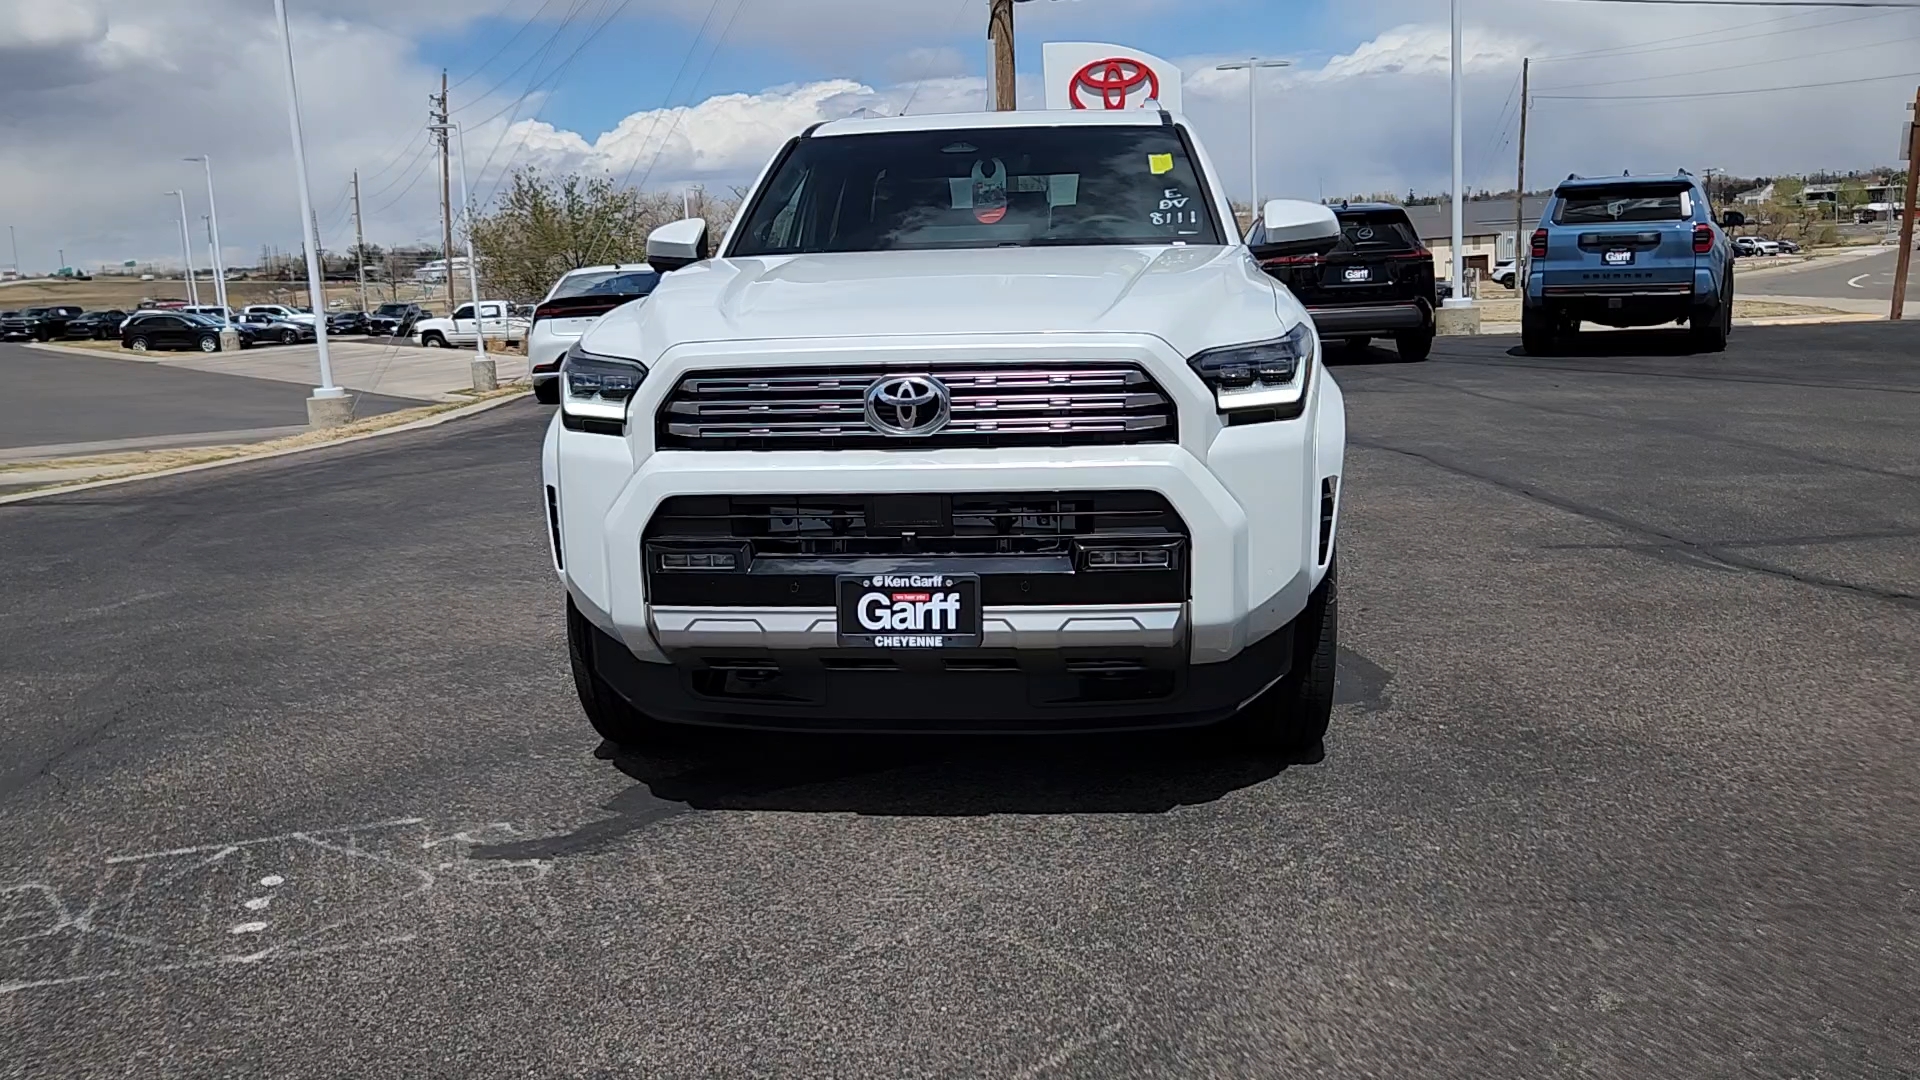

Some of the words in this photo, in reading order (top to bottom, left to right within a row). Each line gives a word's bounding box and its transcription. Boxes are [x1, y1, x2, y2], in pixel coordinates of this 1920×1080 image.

[884, 575, 910, 587] Ken
[910, 575, 943, 587] Garff
[857, 592, 960, 630] Garff
[874, 636, 943, 647] CHEYENNE
